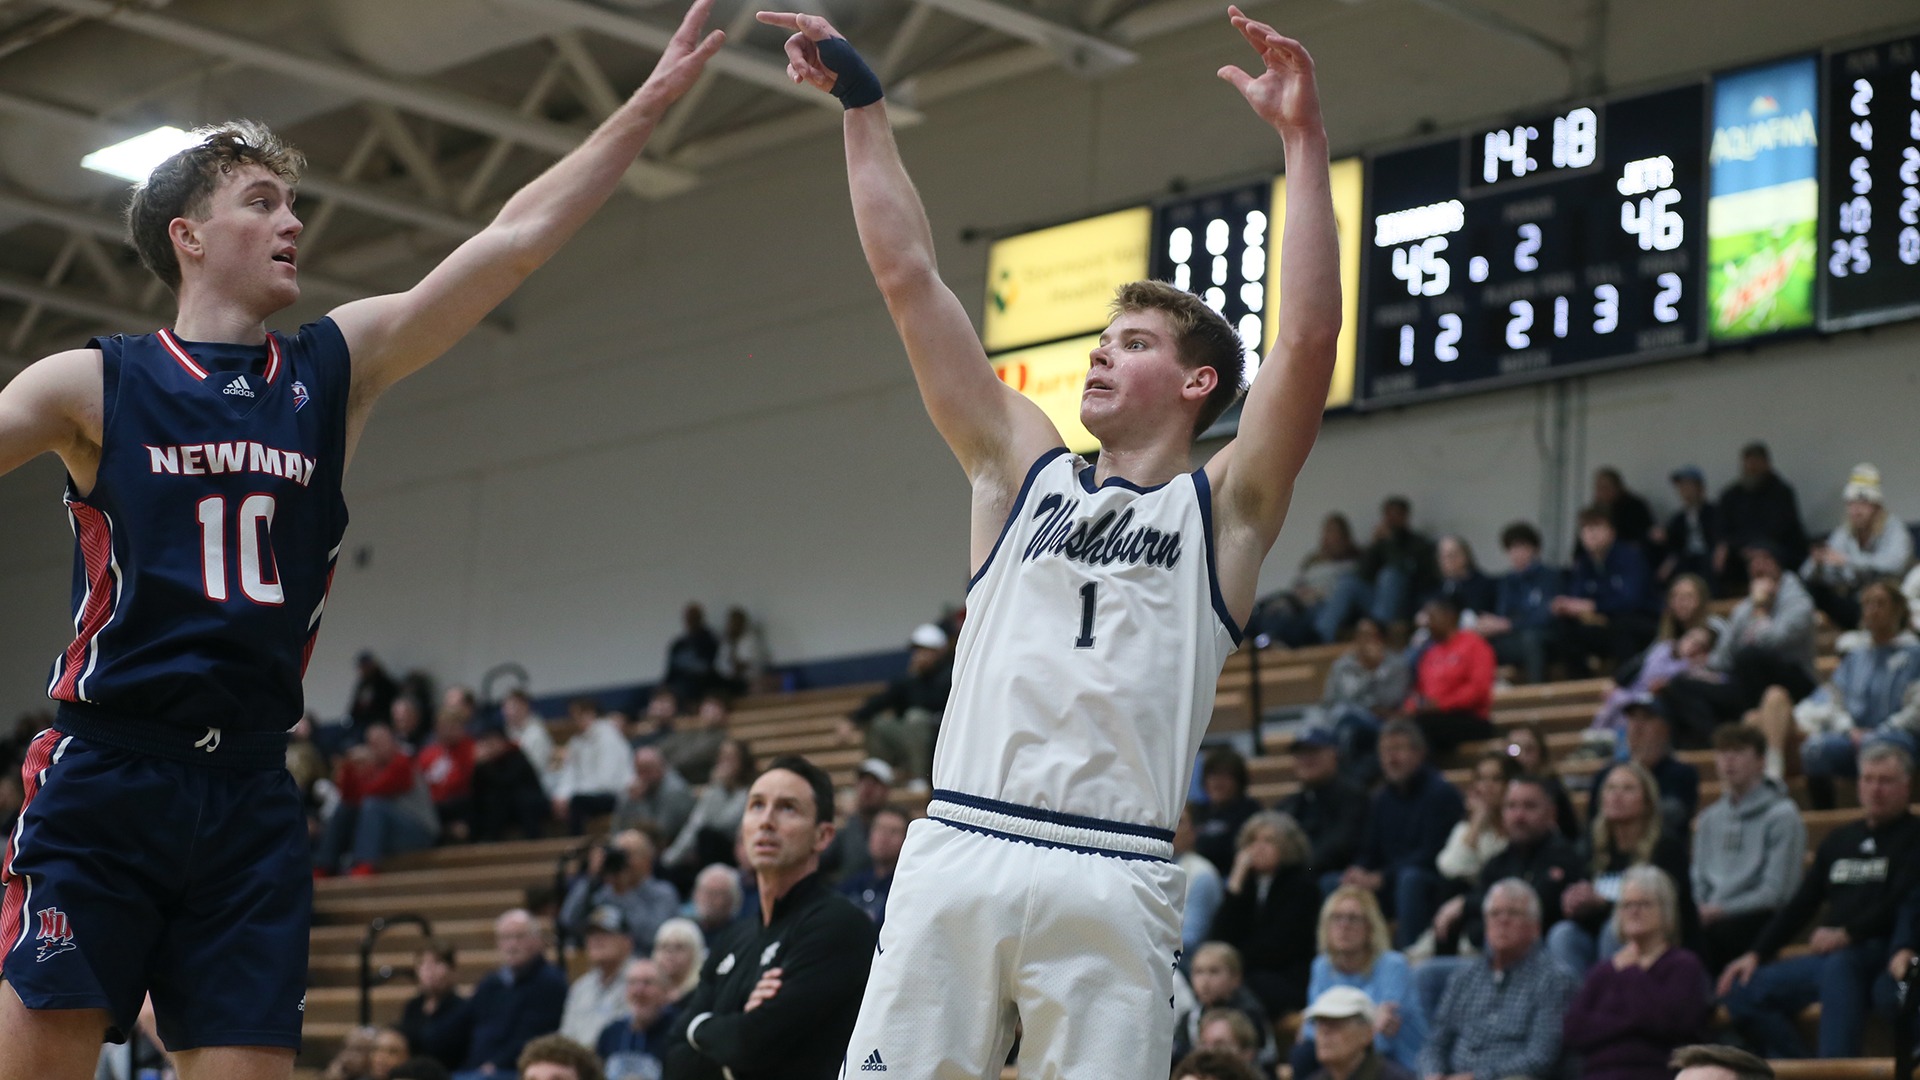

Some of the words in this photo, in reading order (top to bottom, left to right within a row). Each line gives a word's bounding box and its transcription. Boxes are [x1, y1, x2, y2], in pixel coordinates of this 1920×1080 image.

[1851, 79, 1873, 116] 2
[1851, 120, 1872, 150] 4
[1850, 157, 1872, 194] 5
[1621, 189, 1683, 251] 46
[1392, 236, 1449, 296] 45
[1515, 224, 1541, 271] 2
[1830, 236, 1870, 277] 25
[1594, 284, 1618, 333] 3
[1654, 273, 1682, 322] 2
[222, 387, 255, 398] adidas
[196, 491, 285, 607] 10
[1021, 491, 1182, 571] Washburn
[1073, 580, 1099, 650] 1
[860, 1062, 888, 1072] adidas
